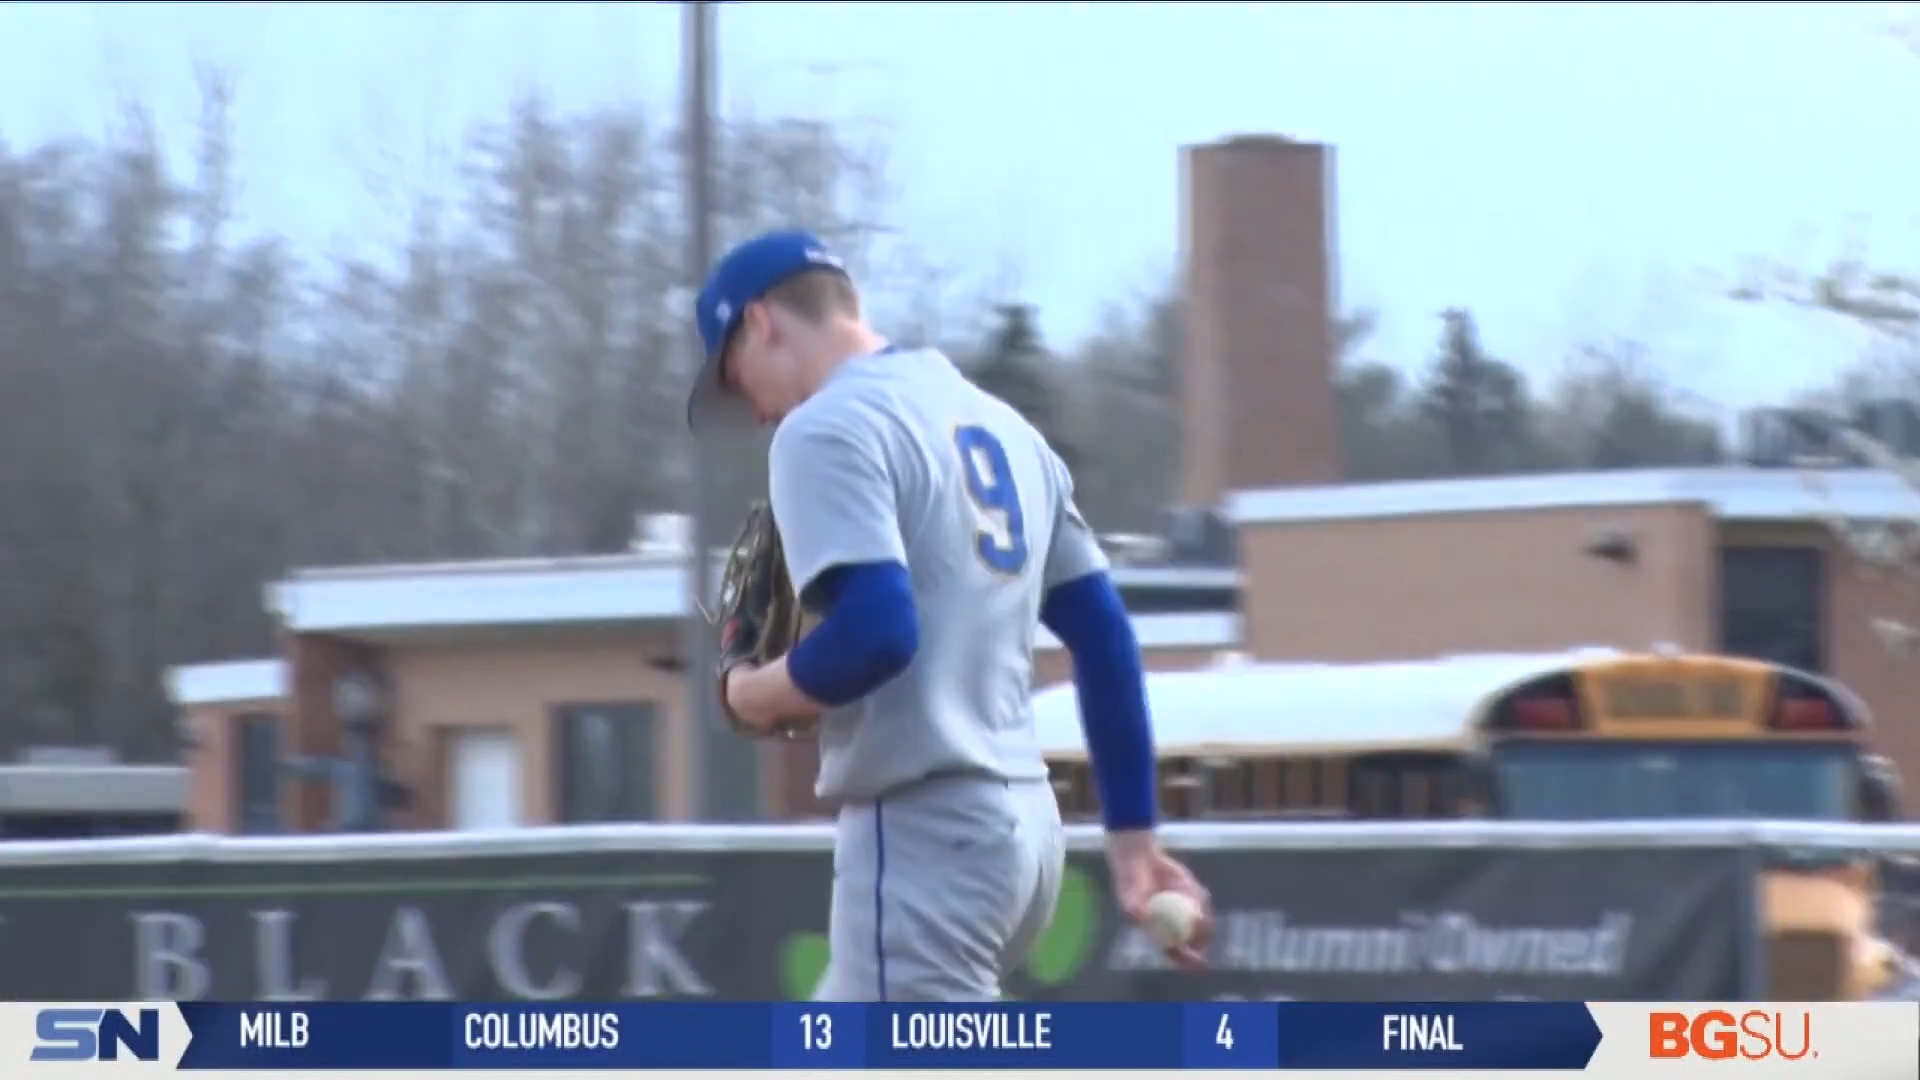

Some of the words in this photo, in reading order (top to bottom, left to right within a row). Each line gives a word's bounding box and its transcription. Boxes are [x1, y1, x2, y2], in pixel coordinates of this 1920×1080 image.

[954, 423, 1028, 576] 9
[127, 901, 714, 1001] BLACK
[1424, 911, 1634, 974] Owned
